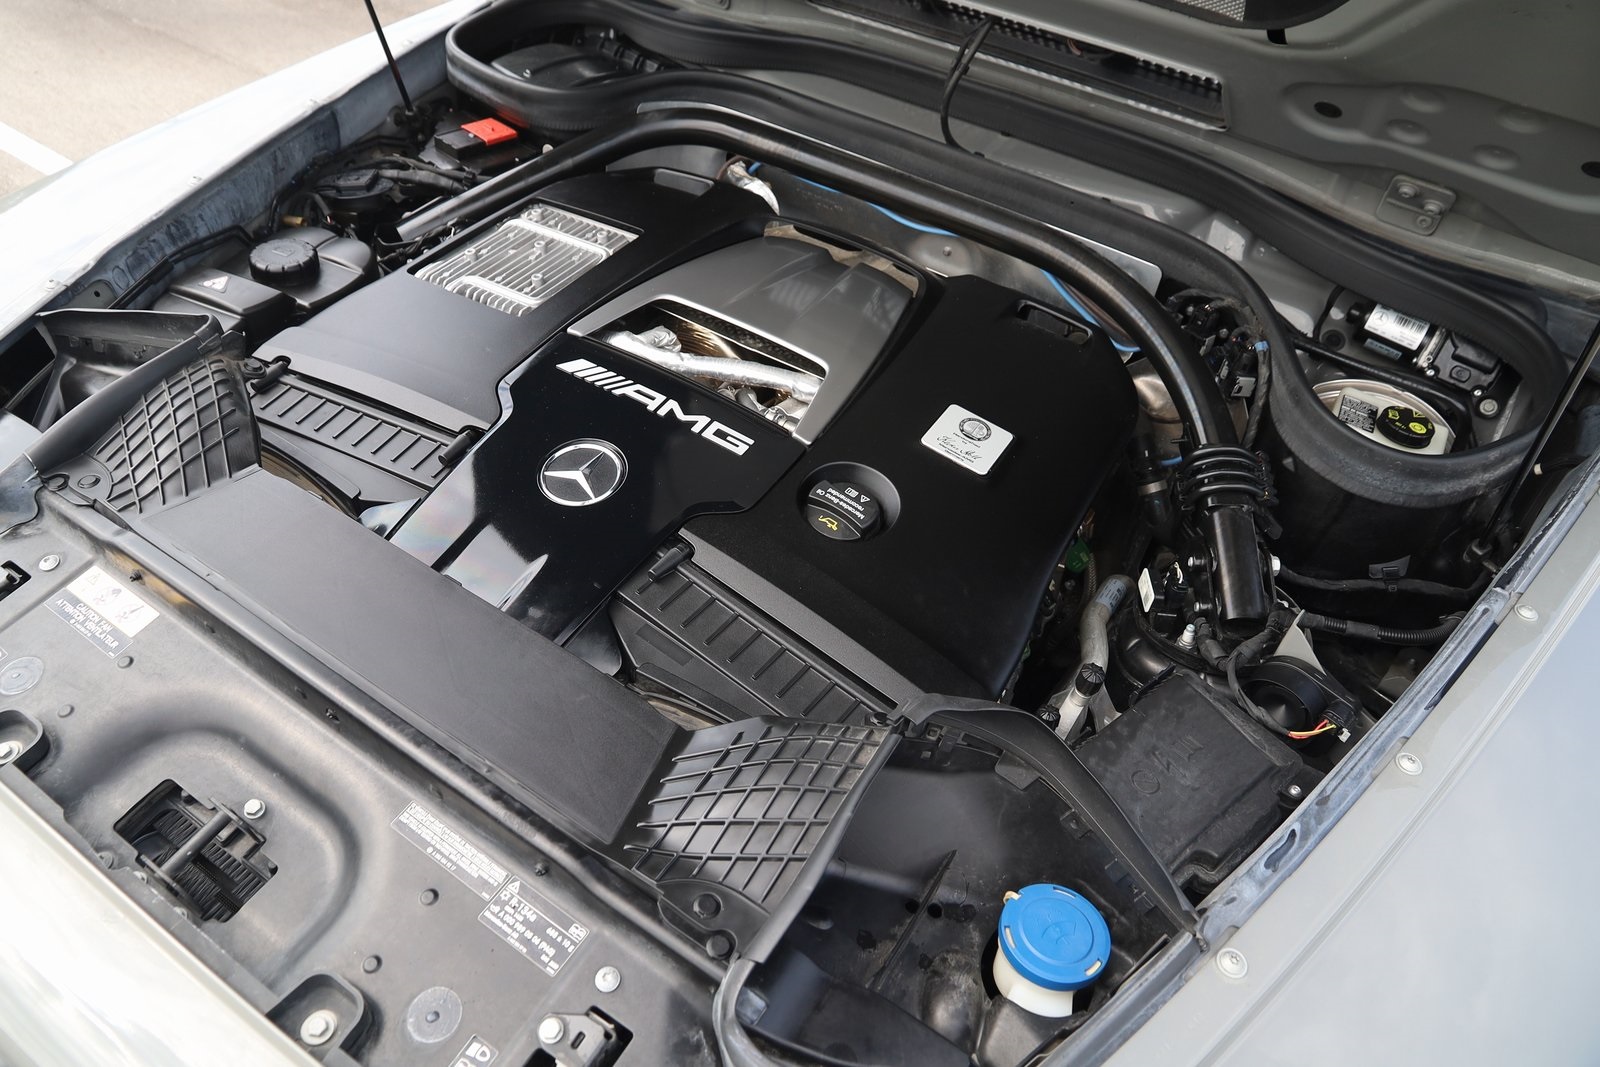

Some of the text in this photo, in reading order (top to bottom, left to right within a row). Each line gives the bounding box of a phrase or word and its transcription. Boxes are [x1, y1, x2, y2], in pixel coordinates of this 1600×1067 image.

[611, 384, 755, 456] AMG
[827, 487, 865, 512] recommended
[55, 597, 86, 622] ATTENTION
[83, 619, 119, 648] VENTILATEUR
[75, 602, 102, 623] CAUTION
[97, 619, 113, 632] FAN
